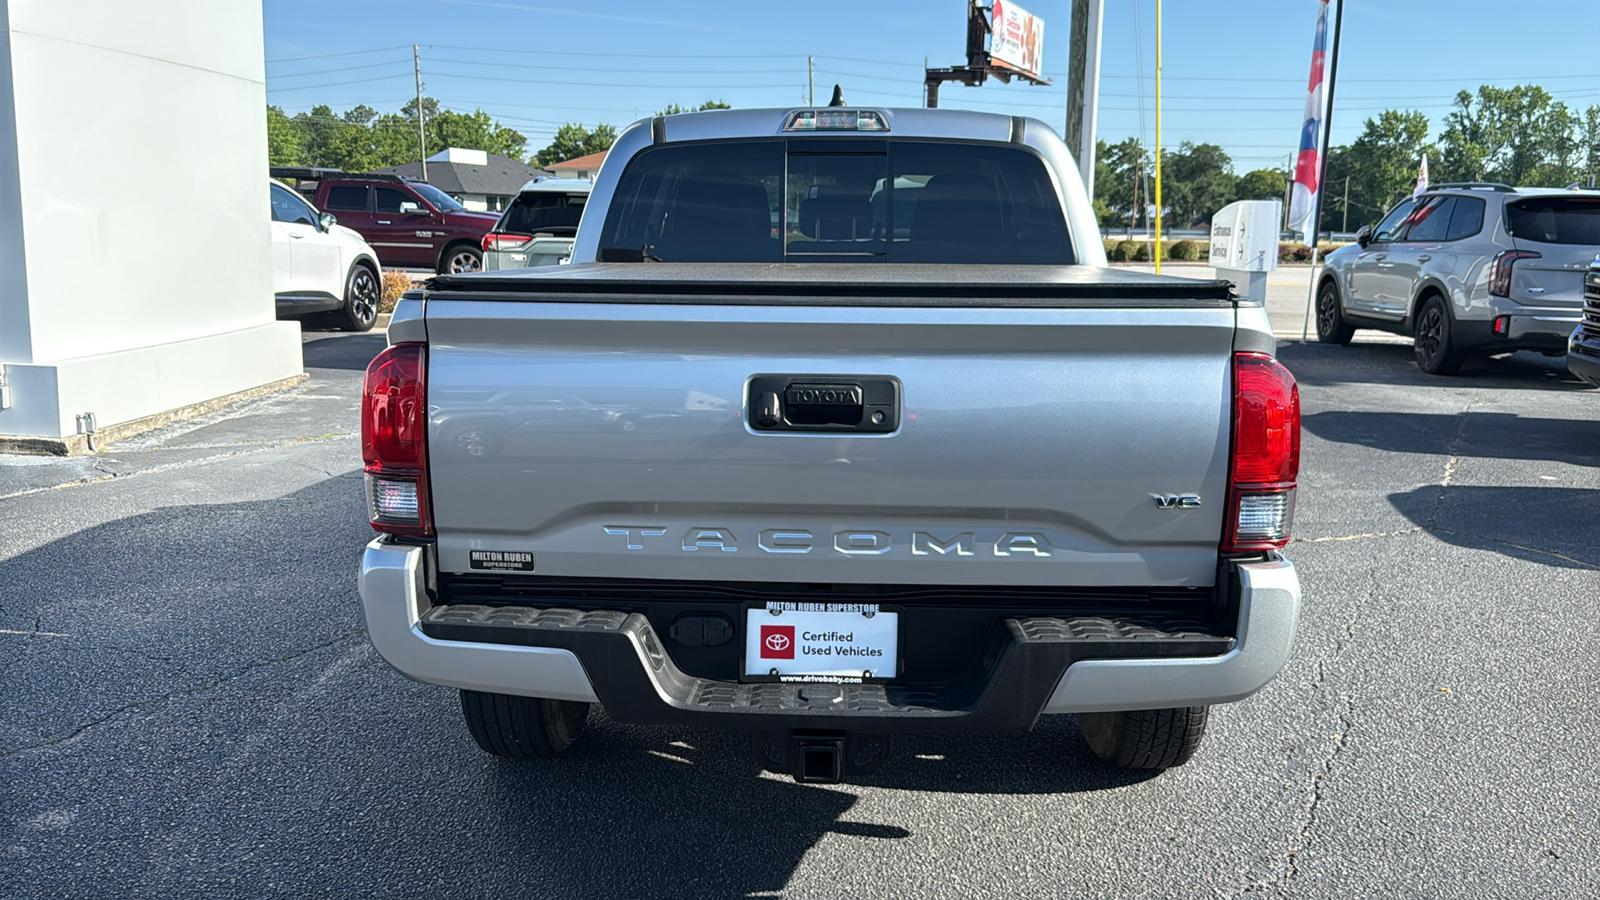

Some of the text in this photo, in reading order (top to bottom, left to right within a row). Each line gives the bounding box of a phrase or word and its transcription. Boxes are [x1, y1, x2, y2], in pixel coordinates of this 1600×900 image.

[1213, 223, 1231, 236] Entrance
[1212, 243, 1227, 257] Service
[792, 389, 857, 403] TOYOTA
[1147, 492, 1201, 509] V6
[603, 525, 1052, 557] TACOMA
[472, 551, 532, 562] MILTON RUBEN
[766, 601, 880, 613] MILTON RUBEN SUPERSTORE
[802, 631, 853, 642] Certified
[802, 645, 883, 657] Used Vehicles
[780, 674, 863, 685] www.drivebaby.com
